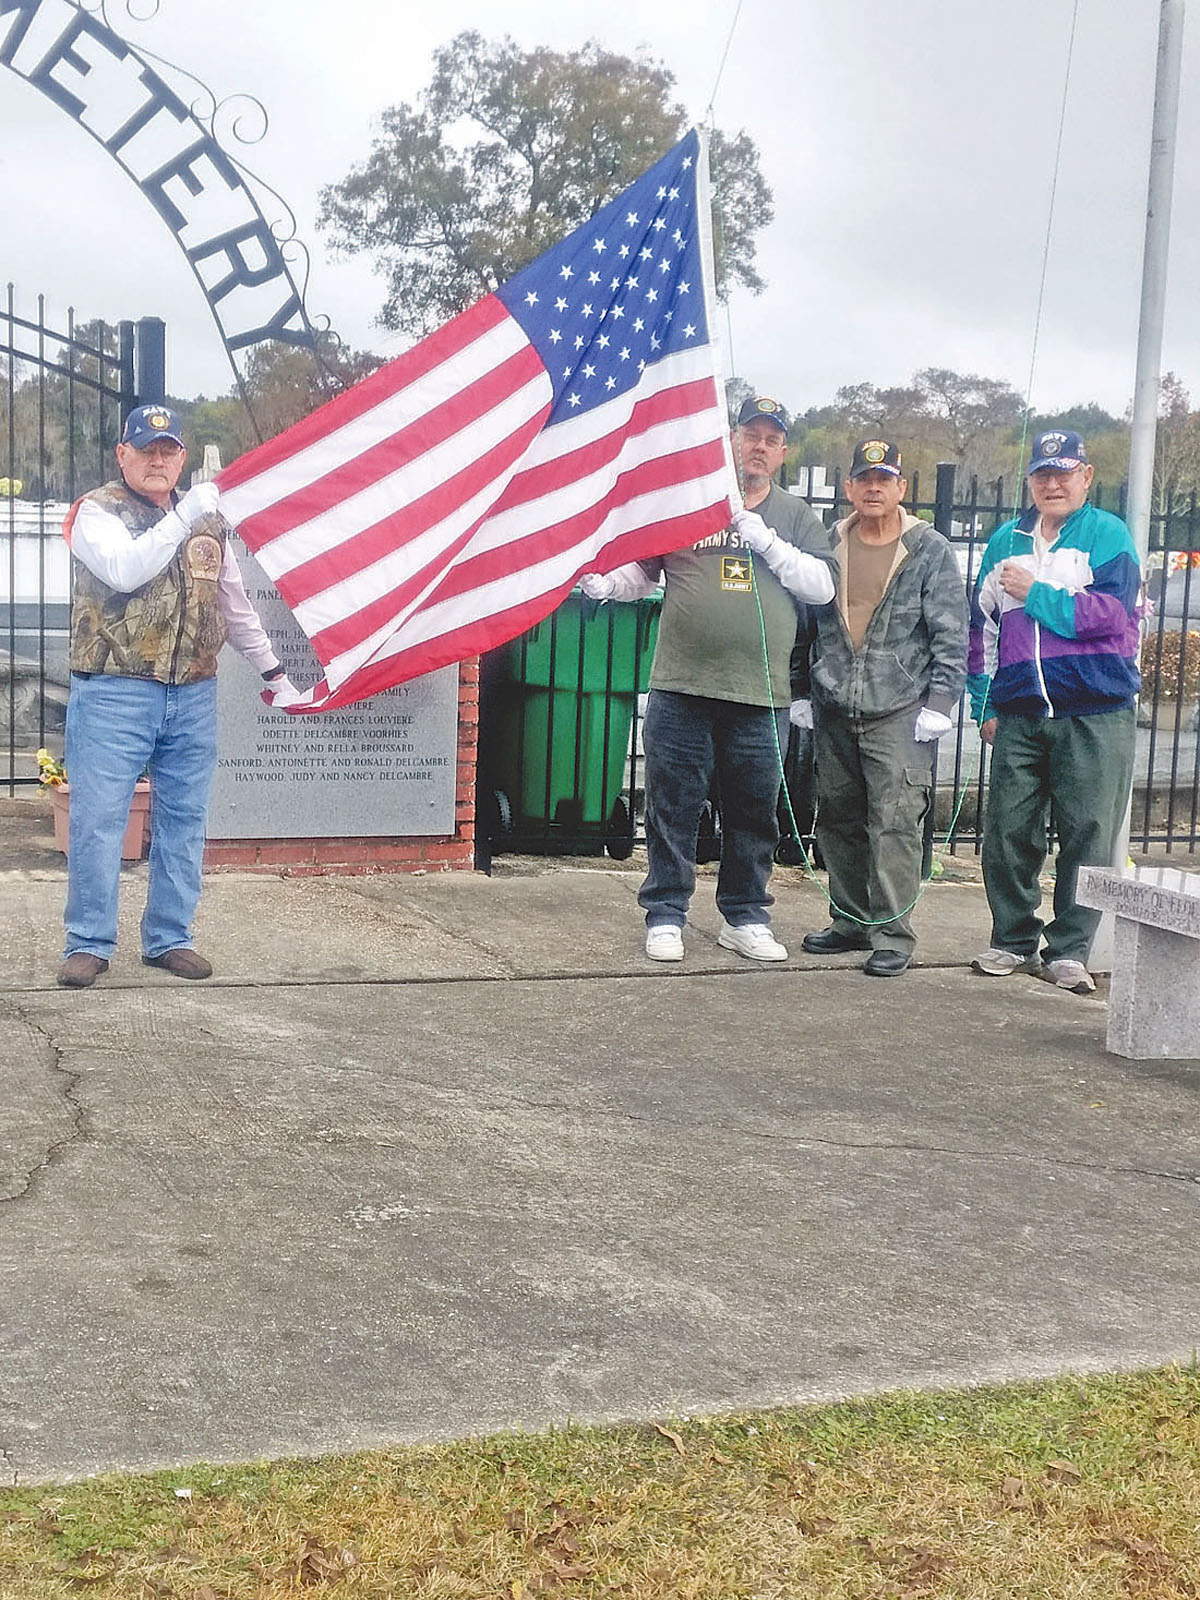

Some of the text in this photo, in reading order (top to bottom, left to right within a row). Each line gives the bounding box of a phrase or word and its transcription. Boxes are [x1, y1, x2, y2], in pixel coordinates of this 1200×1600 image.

[256, 715, 414, 725] HAROLD AND FRANCES LOUVIERE
[262, 729, 409, 739] ODETTE DELCAMBRE VOORHIES
[256, 743, 300, 754] WHITNEY
[303, 743, 324, 753] AND
[361, 743, 415, 753] BROUSSARD
[267, 758, 328, 768] ANTOINETTE
[331, 757, 351, 767] AND
[354, 757, 392, 767] RONALD
[395, 757, 450, 767] DELCAMBRE
[289, 772, 315, 782] JUDY
[319, 772, 340, 782] AND
[343, 771, 376, 781] NANCY
[379, 771, 433, 781] DELCAMBRE
